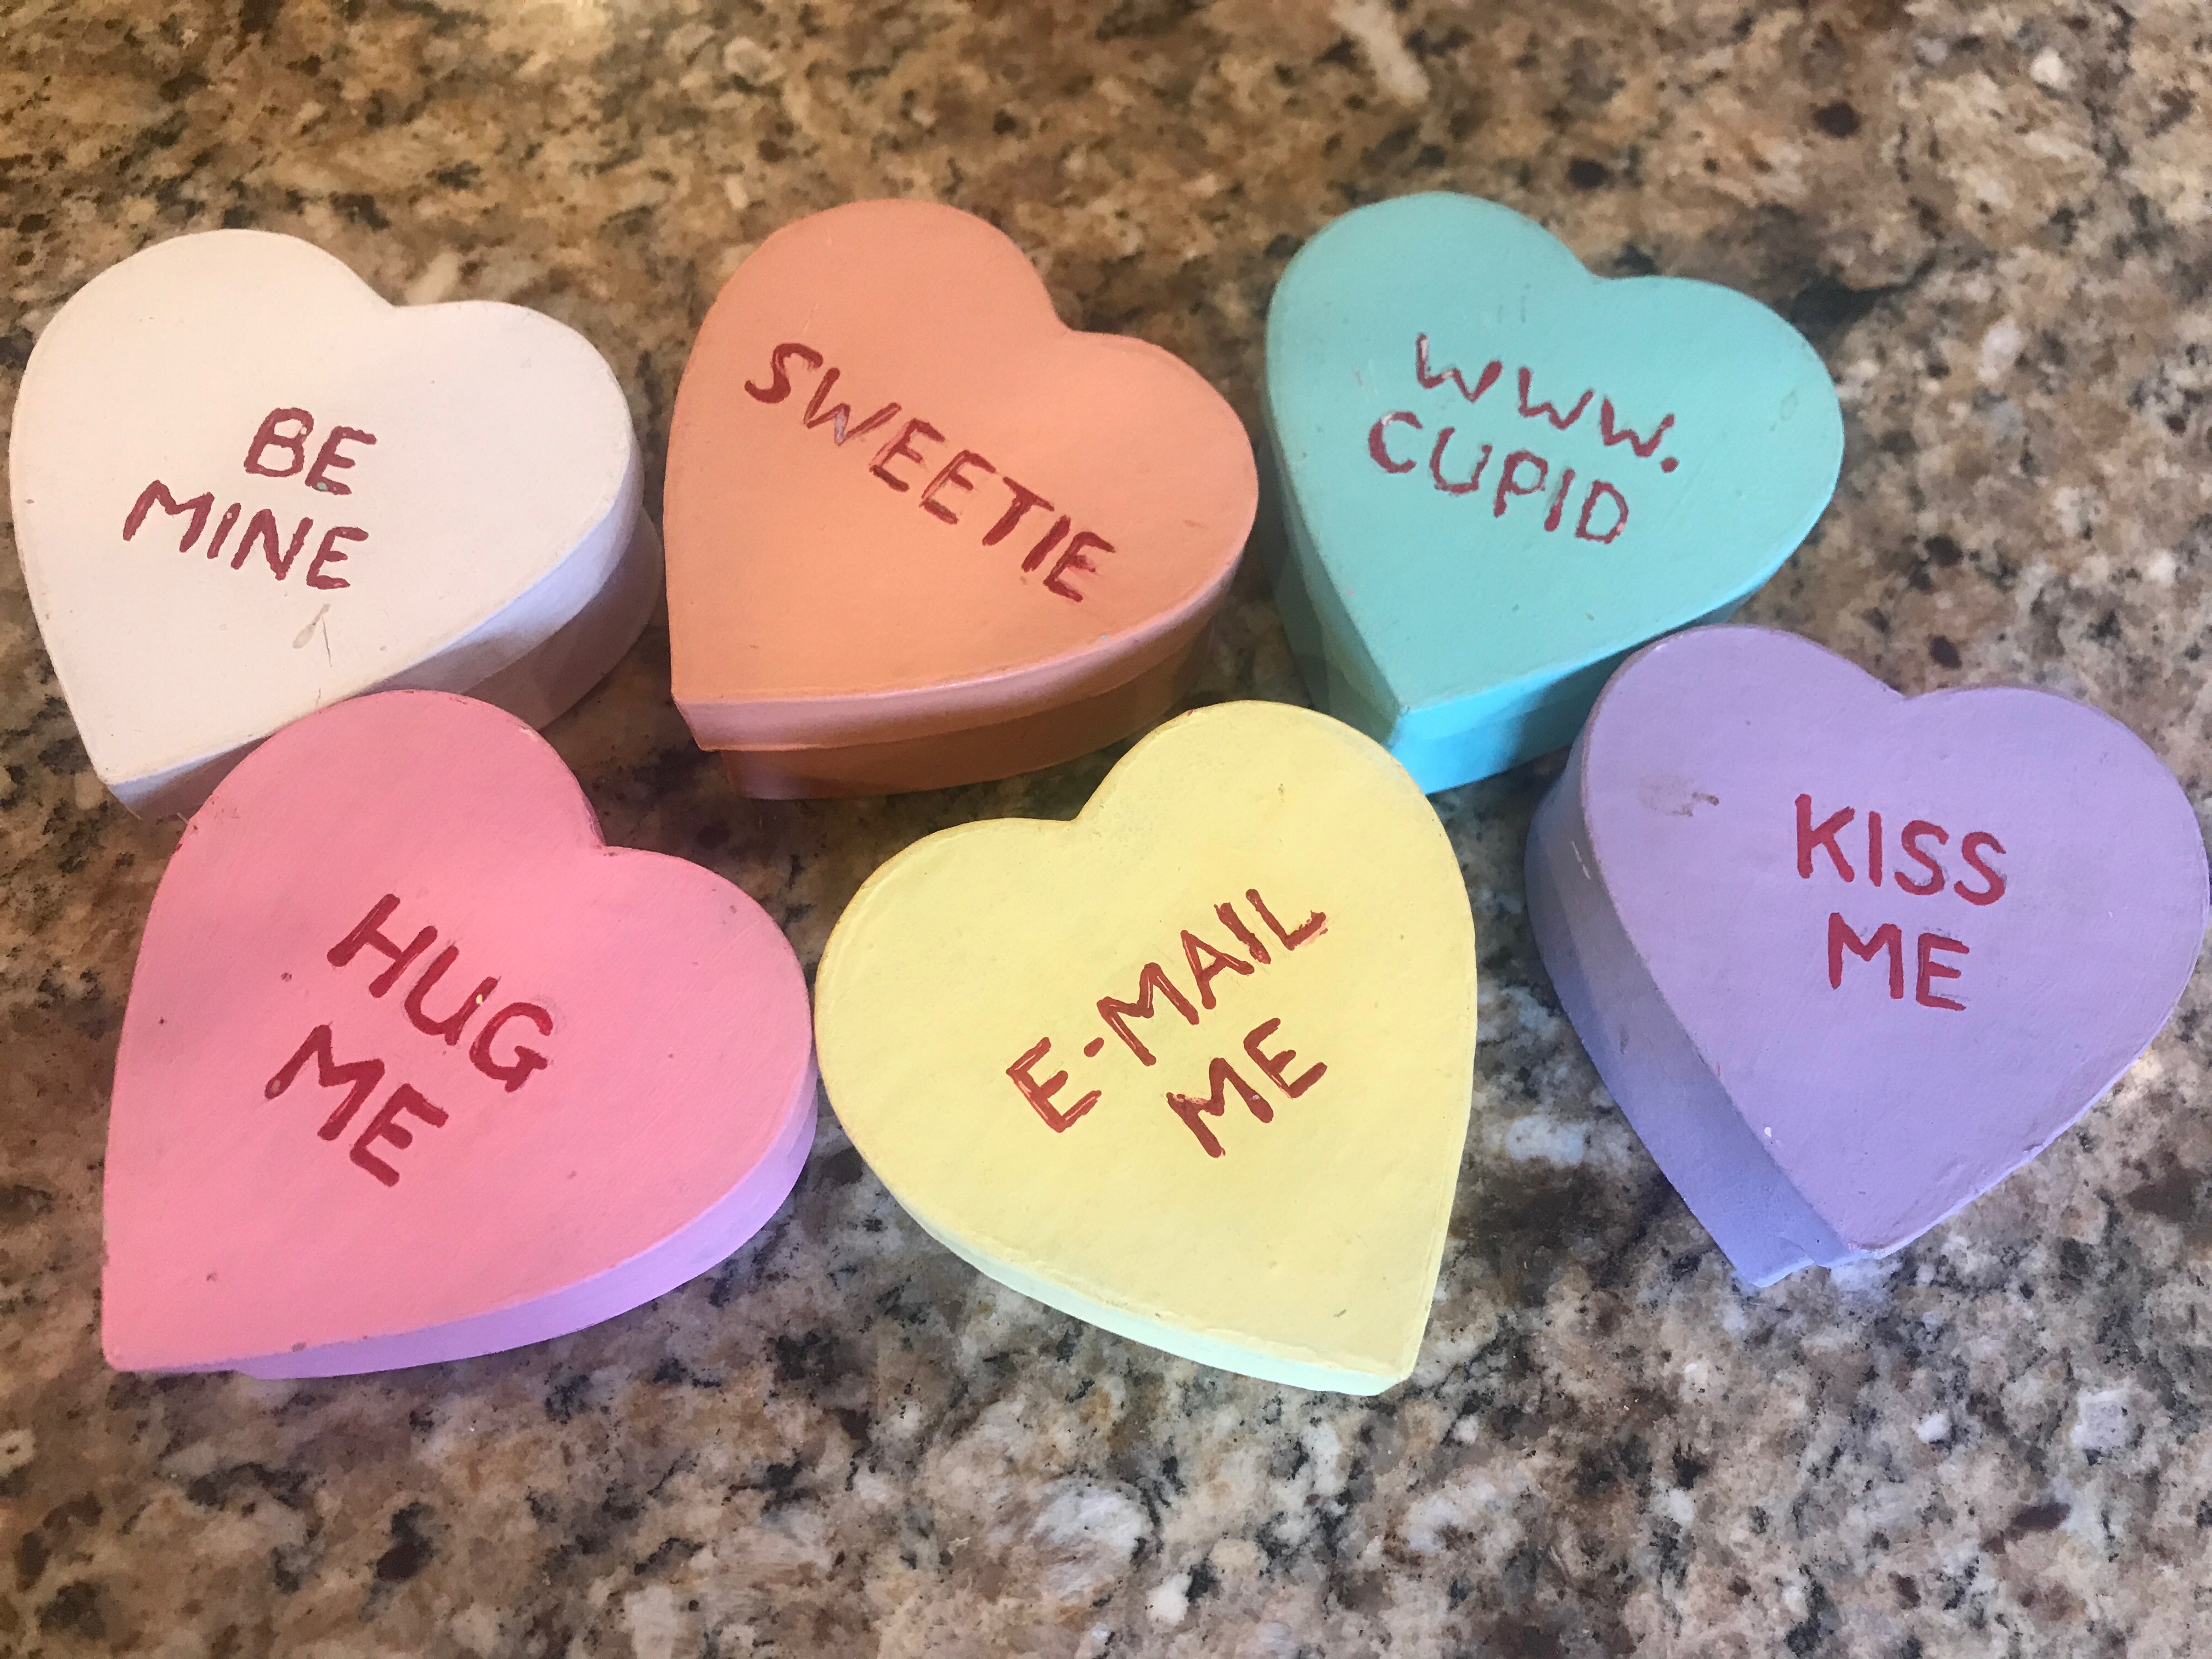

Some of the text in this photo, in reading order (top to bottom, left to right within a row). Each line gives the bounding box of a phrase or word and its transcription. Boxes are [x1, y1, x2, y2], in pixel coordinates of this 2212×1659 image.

[243, 407, 377, 495] BE
[744, 342, 1116, 603] SWEETIE
[1367, 413, 1629, 545] CUPID
[122, 479, 369, 590] MINE
[1795, 793, 2007, 906] KISS
[326, 893, 554, 1093] HUG
[1006, 888, 1327, 1133] E-MAIL
[1827, 912, 1970, 1012] ME
[264, 1024, 449, 1187] ME
[1166, 1017, 1328, 1159] ME
